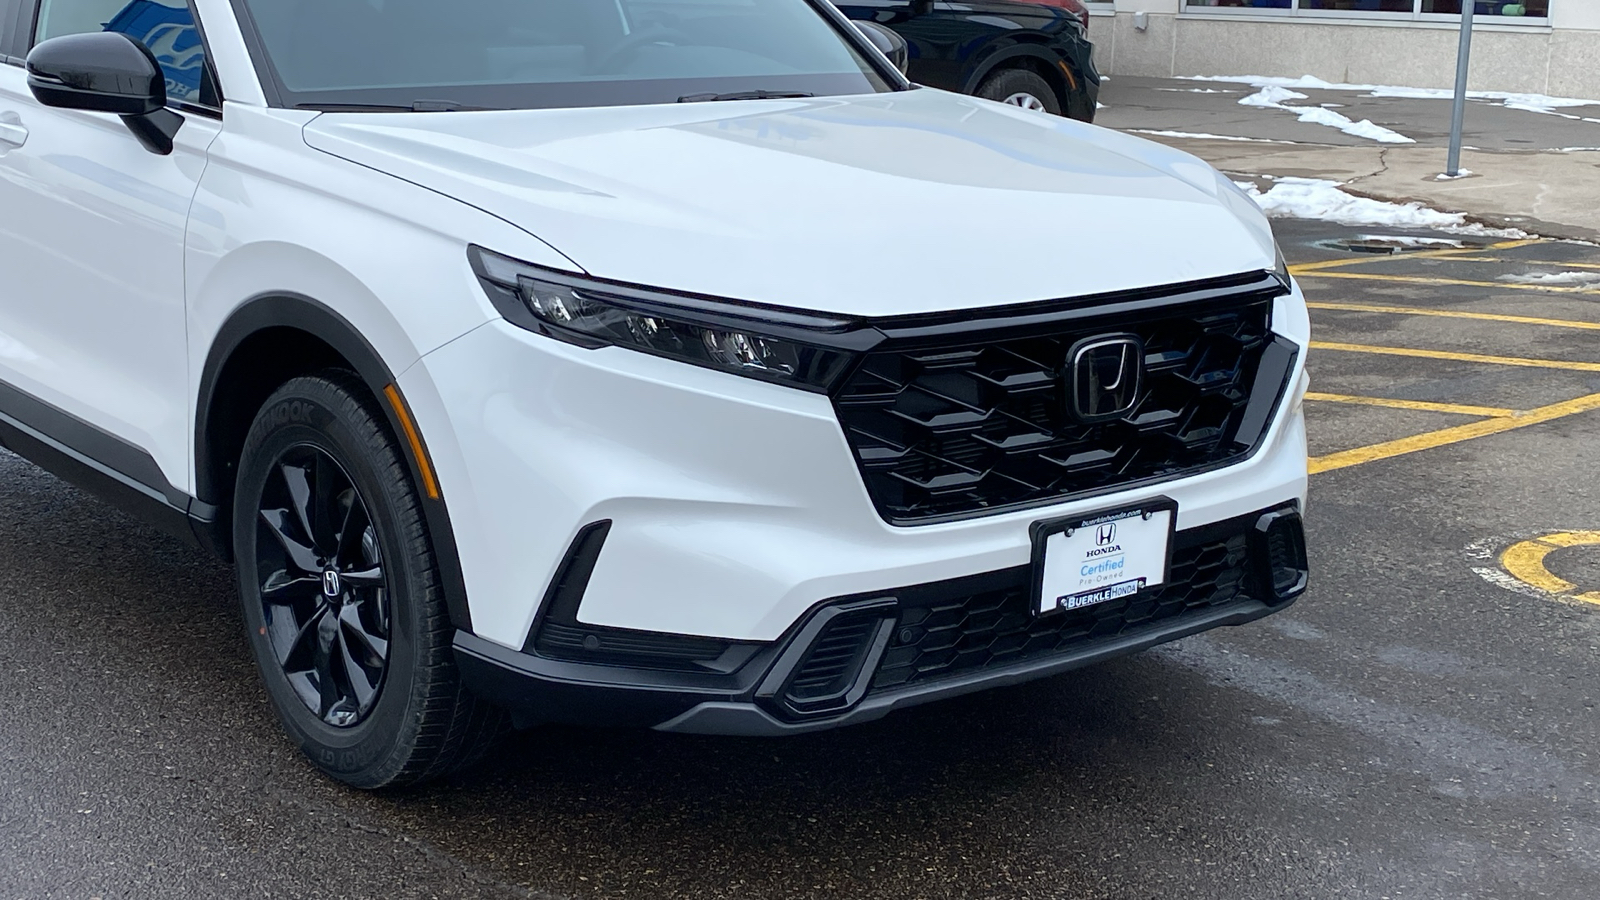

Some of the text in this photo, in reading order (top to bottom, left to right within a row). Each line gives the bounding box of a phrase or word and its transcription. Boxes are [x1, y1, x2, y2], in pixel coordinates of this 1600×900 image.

[1086, 545, 1121, 557] HONDA
[1080, 557, 1124, 576] Certified
[1079, 571, 1123, 585] Pre-Owned
[1068, 584, 1136, 608] BUERKLE HONDA
